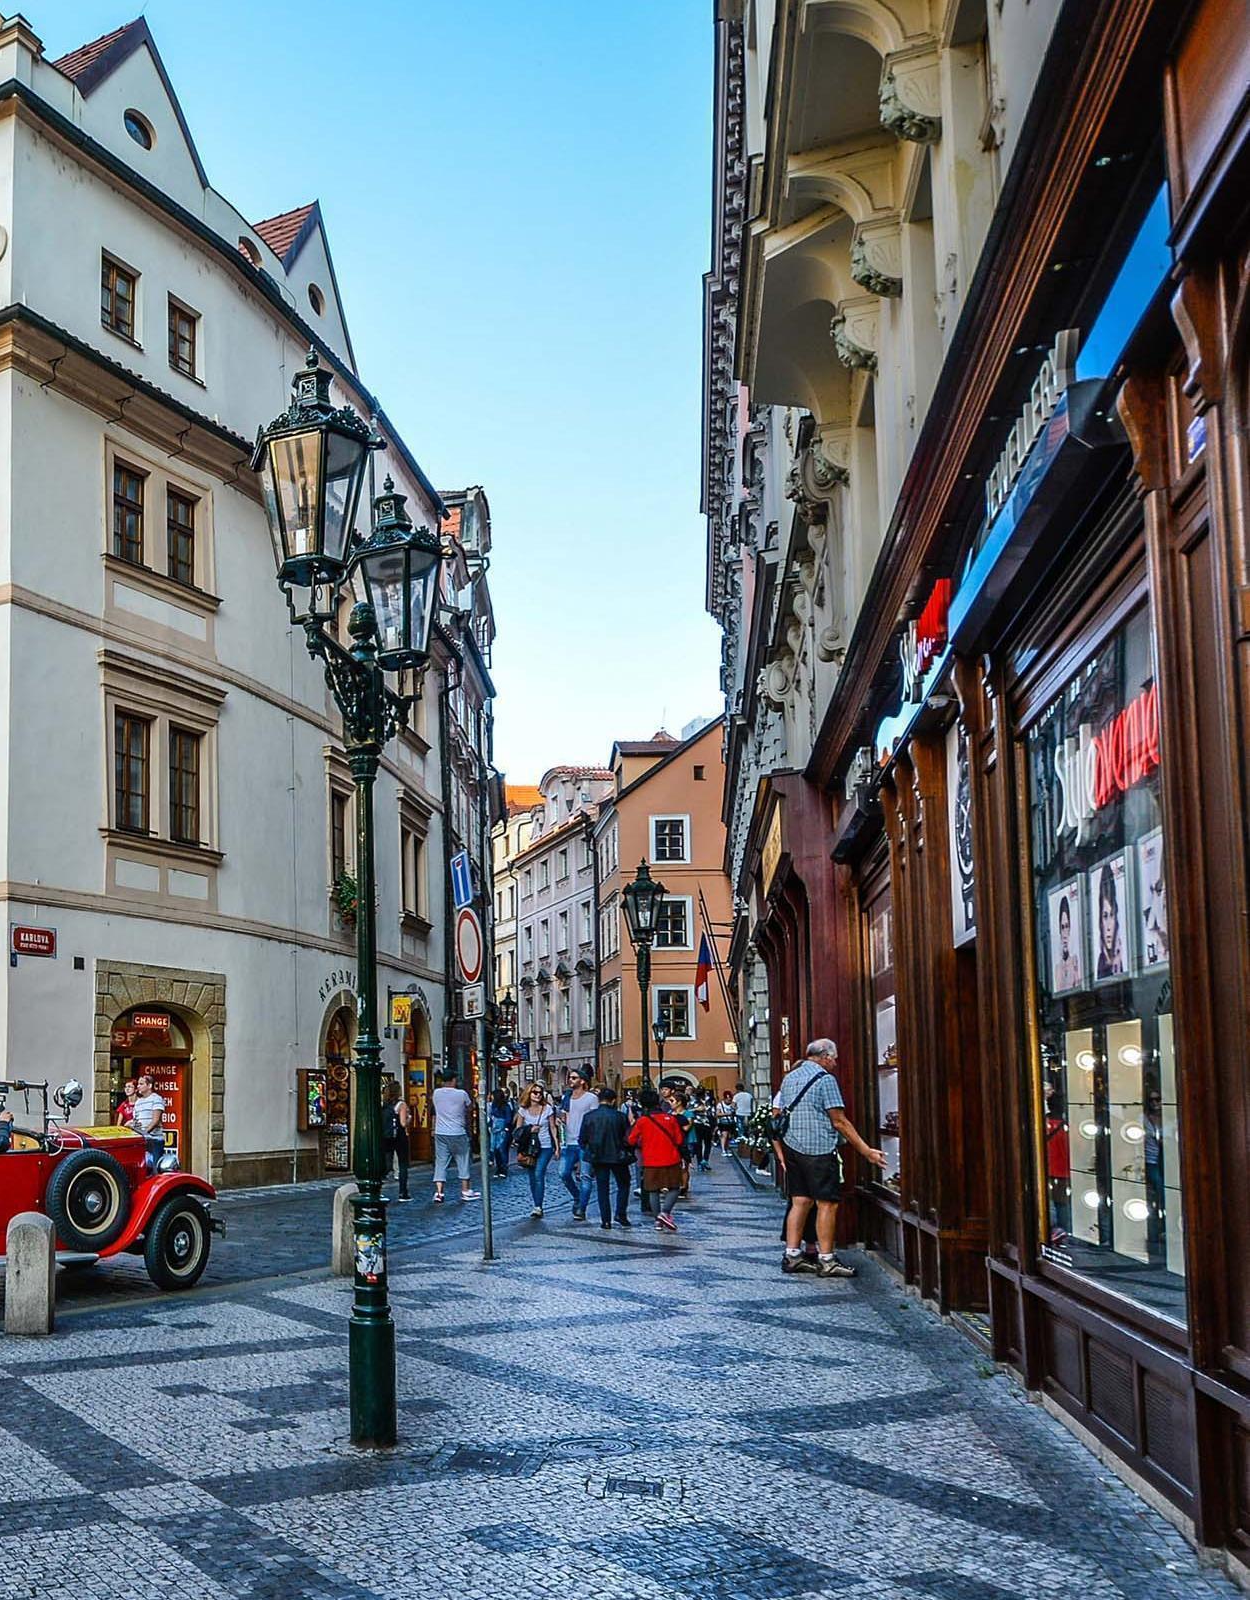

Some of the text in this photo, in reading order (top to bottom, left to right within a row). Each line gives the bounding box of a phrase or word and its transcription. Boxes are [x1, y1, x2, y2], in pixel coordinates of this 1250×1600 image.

[20, 932, 50, 944] KARLOVA
[134, 1016, 168, 1026] CHANGE
[144, 1065, 177, 1075] CHANGE
[153, 1081, 180, 1091] CHSEL
